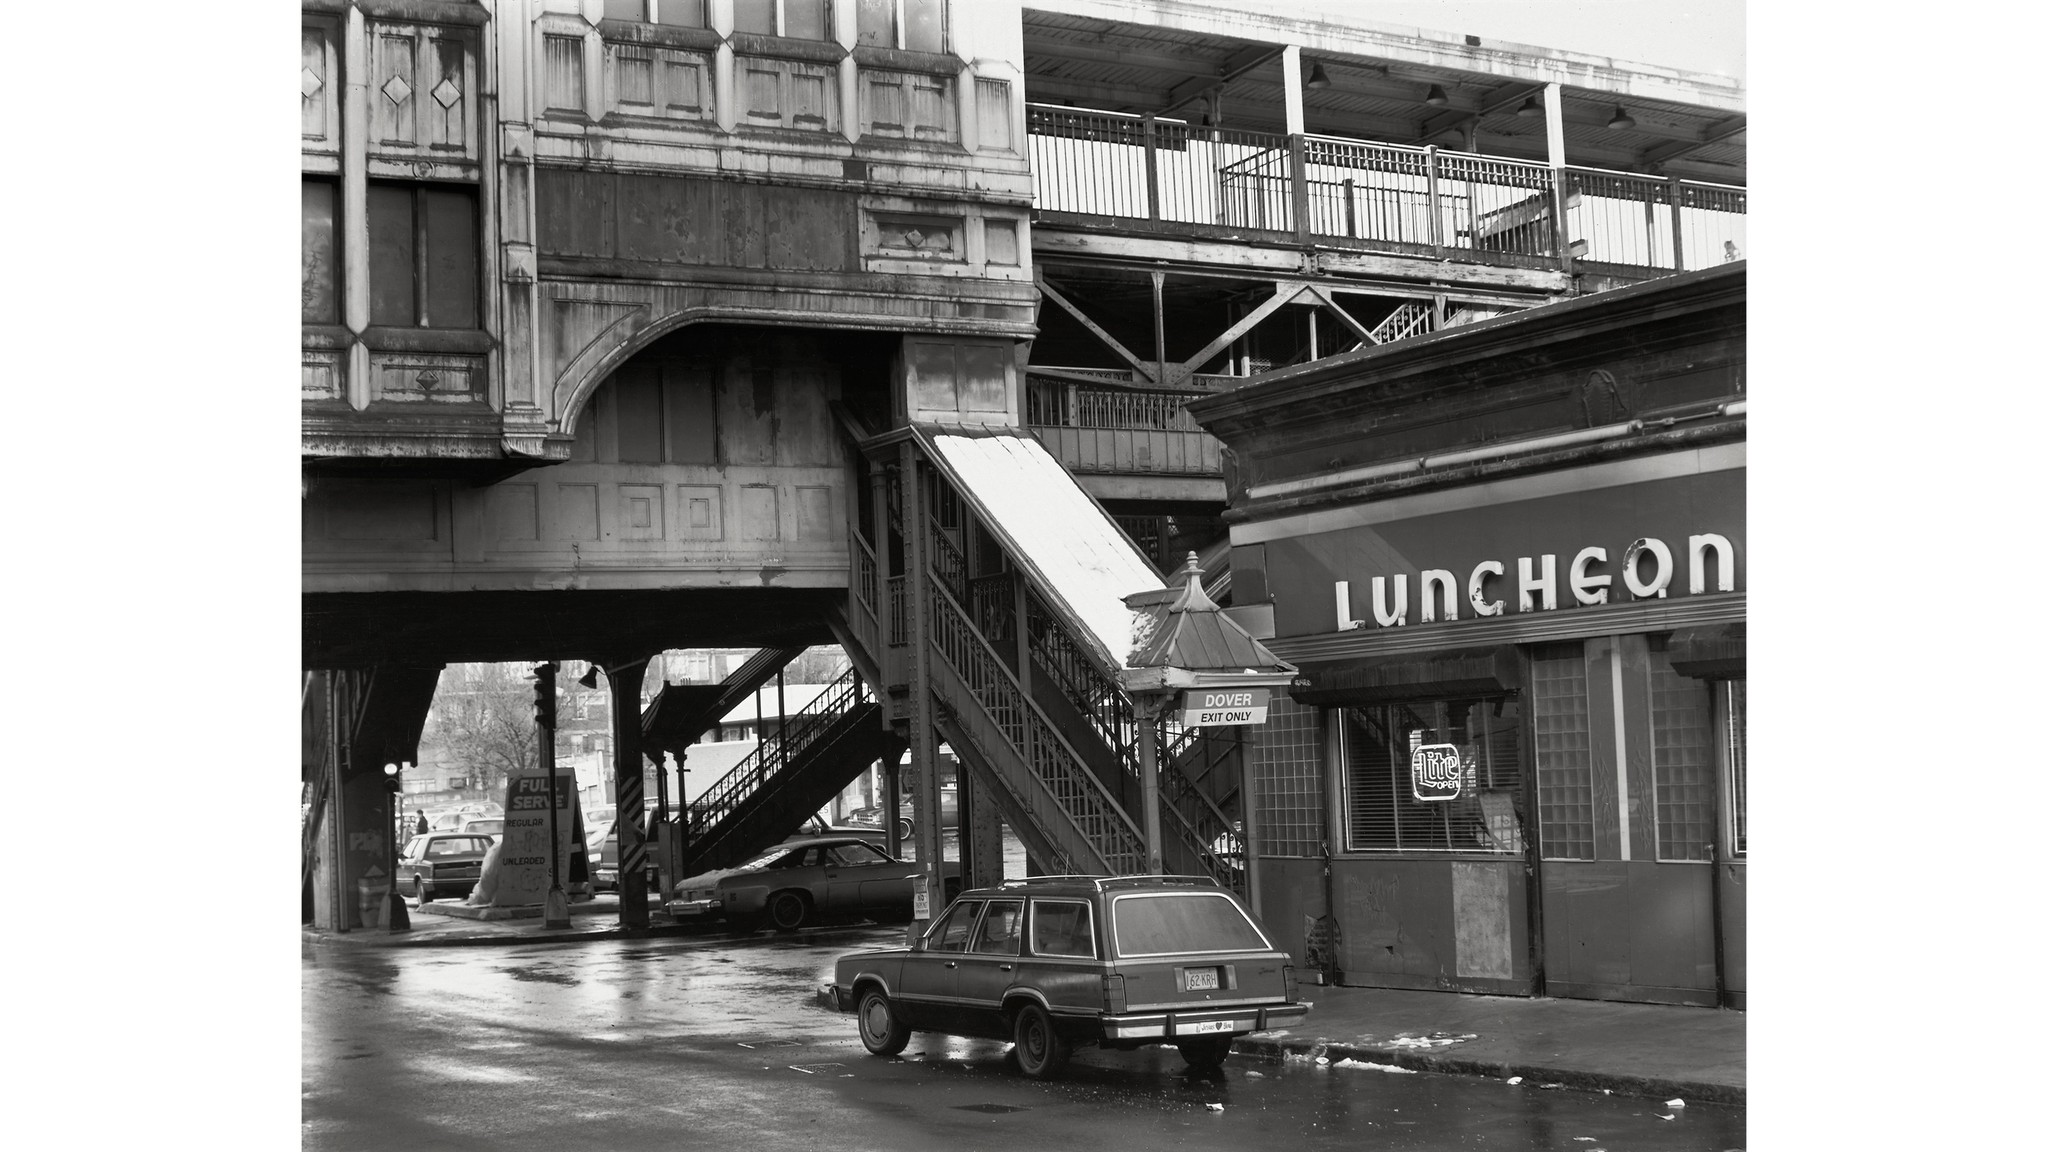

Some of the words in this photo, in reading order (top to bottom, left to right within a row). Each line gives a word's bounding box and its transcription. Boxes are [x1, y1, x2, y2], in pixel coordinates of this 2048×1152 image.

[1335, 532, 1735, 632] LUNCHEON
[1205, 693, 1252, 707] DOVER
[1200, 712, 1223, 723] EXIT
[1225, 711, 1252, 722] ONLY
[1417, 751, 1459, 788] Lite
[520, 779, 559, 792] FUL
[1436, 780, 1460, 790] OPEN
[506, 819, 543, 827] REGULAR
[503, 857, 545, 865] UNLEADED
